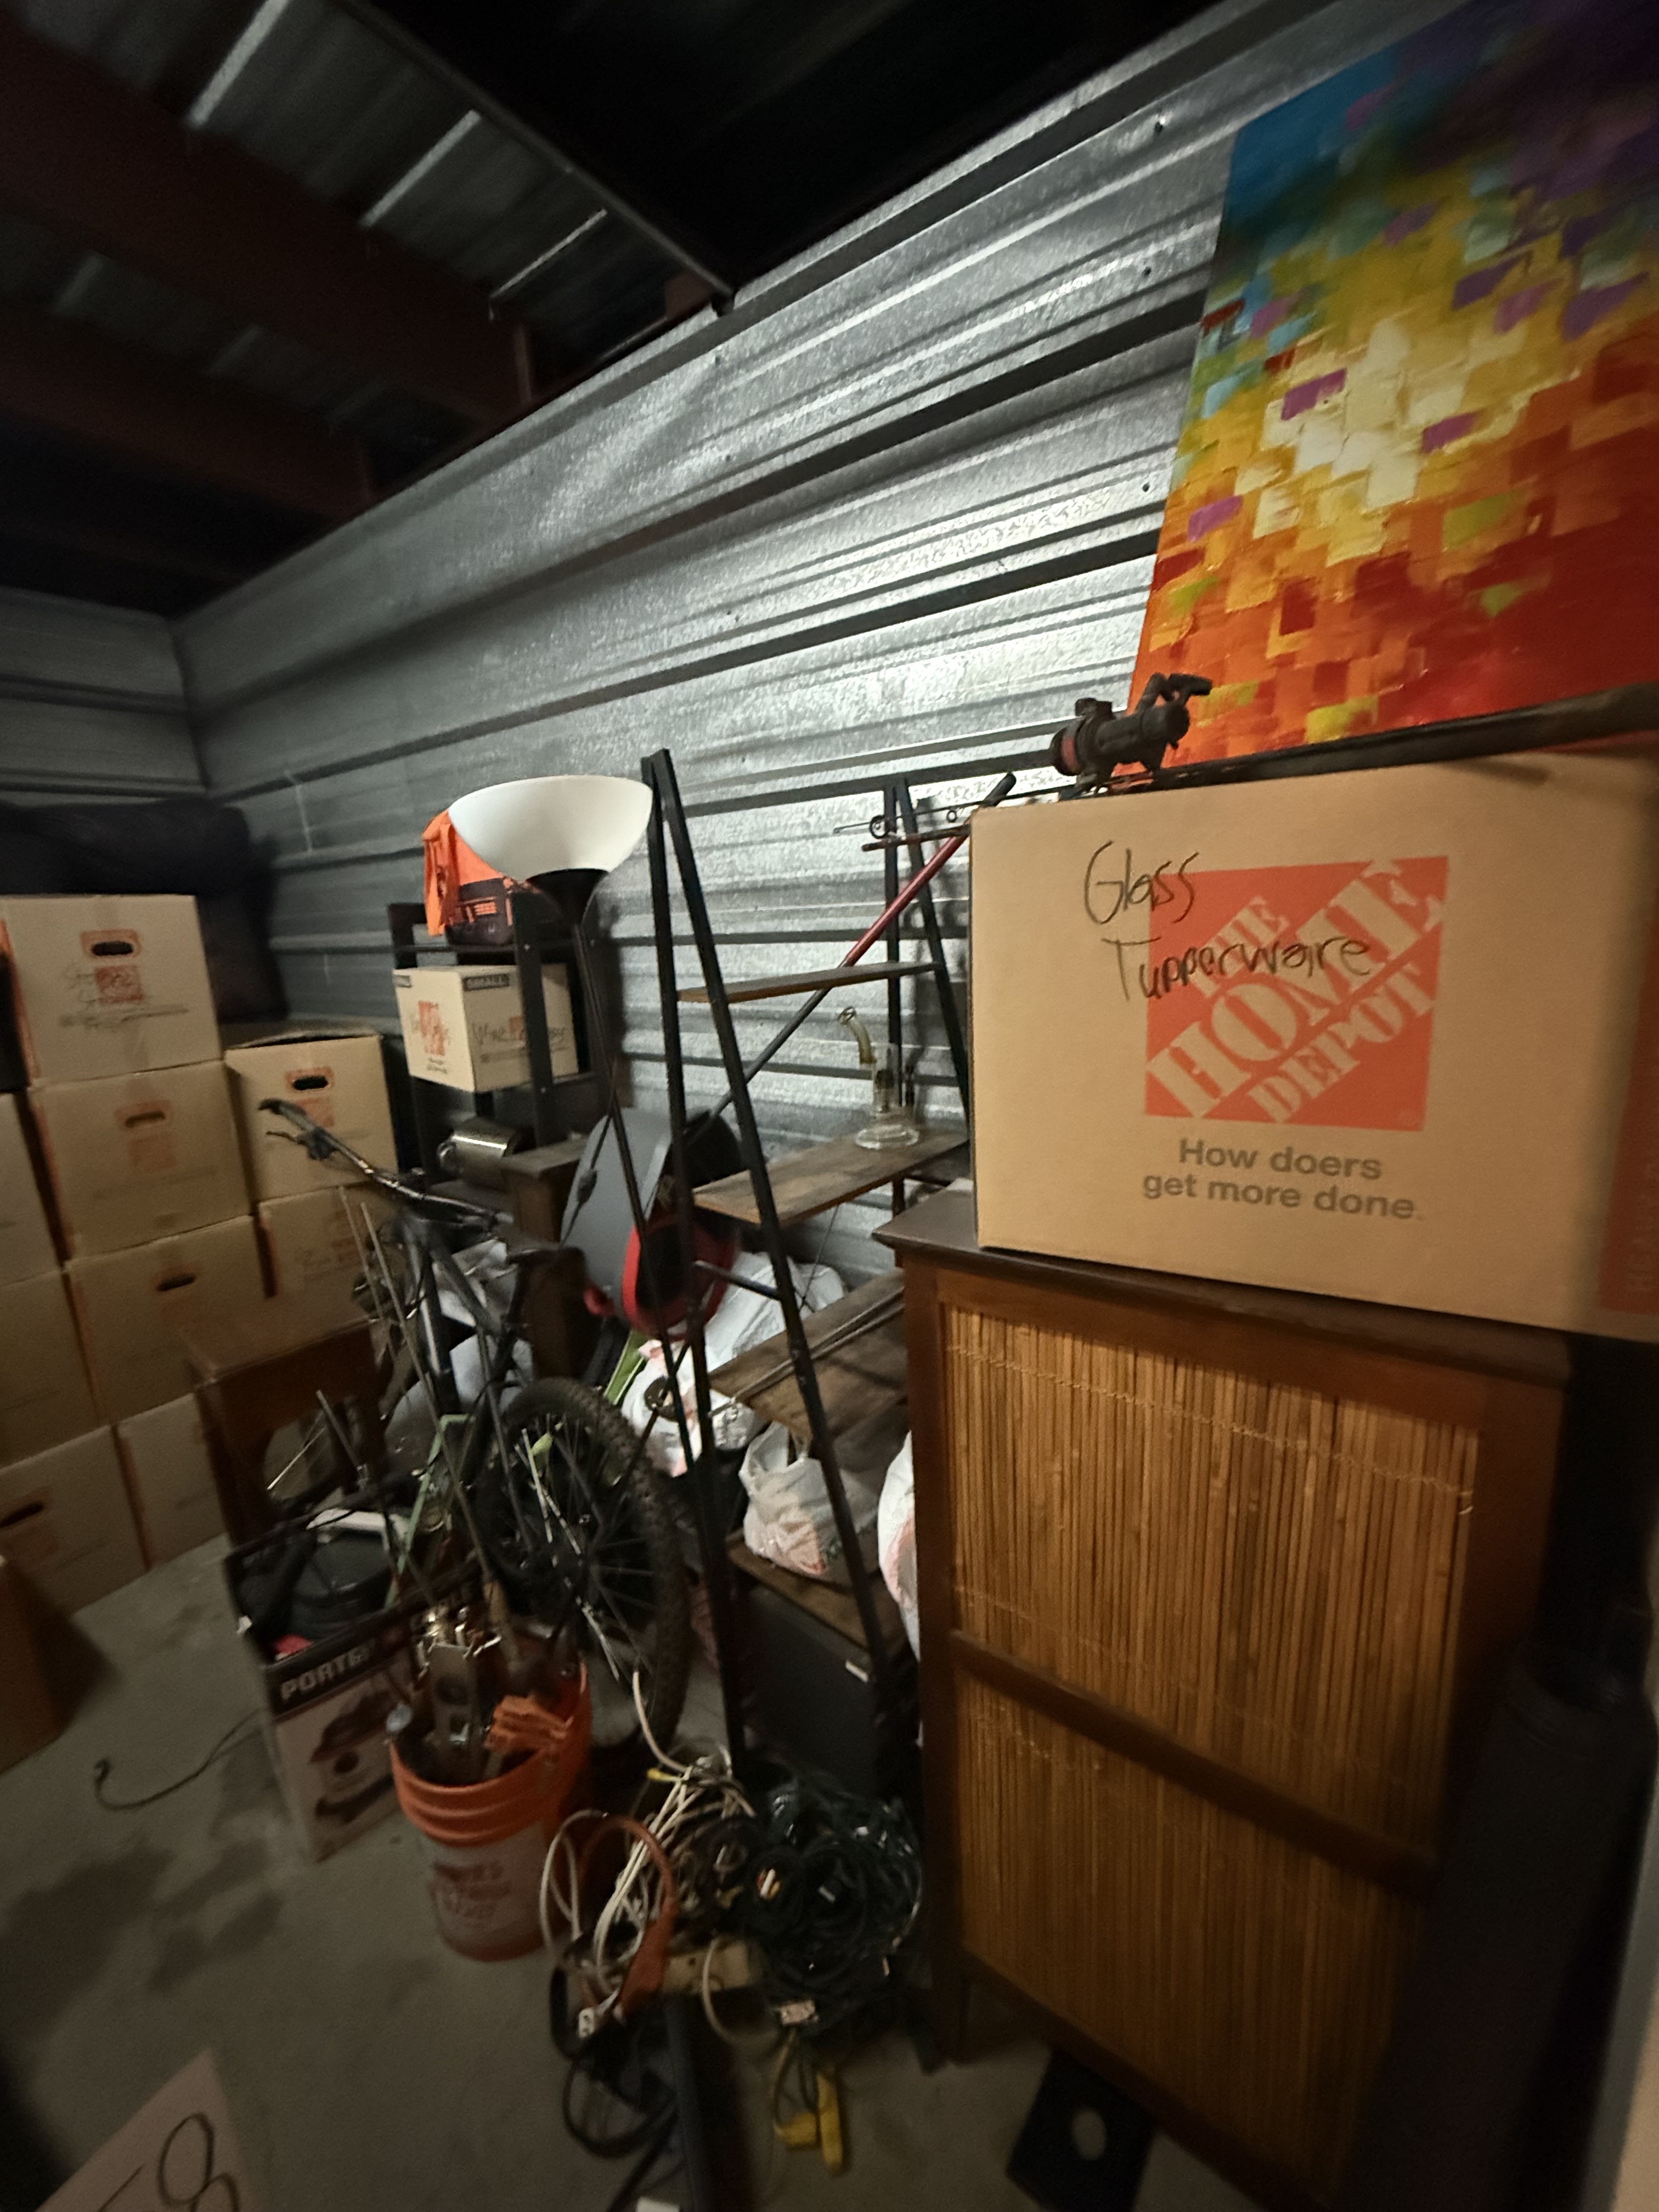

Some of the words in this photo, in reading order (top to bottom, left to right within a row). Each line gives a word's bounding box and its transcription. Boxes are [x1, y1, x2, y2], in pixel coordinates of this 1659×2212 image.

[1084, 839, 1200, 924] Glass
[1101, 935, 1370, 1002] Tupperware
[1146, 858, 1445, 1119] HOME
[1248, 960, 1436, 1125] DEPOT
[1143, 1173, 1197, 1200] get
[1207, 1180, 1301, 1207] more
[1179, 1138, 1258, 1170] How
[1269, 1146, 1382, 1180] doers
